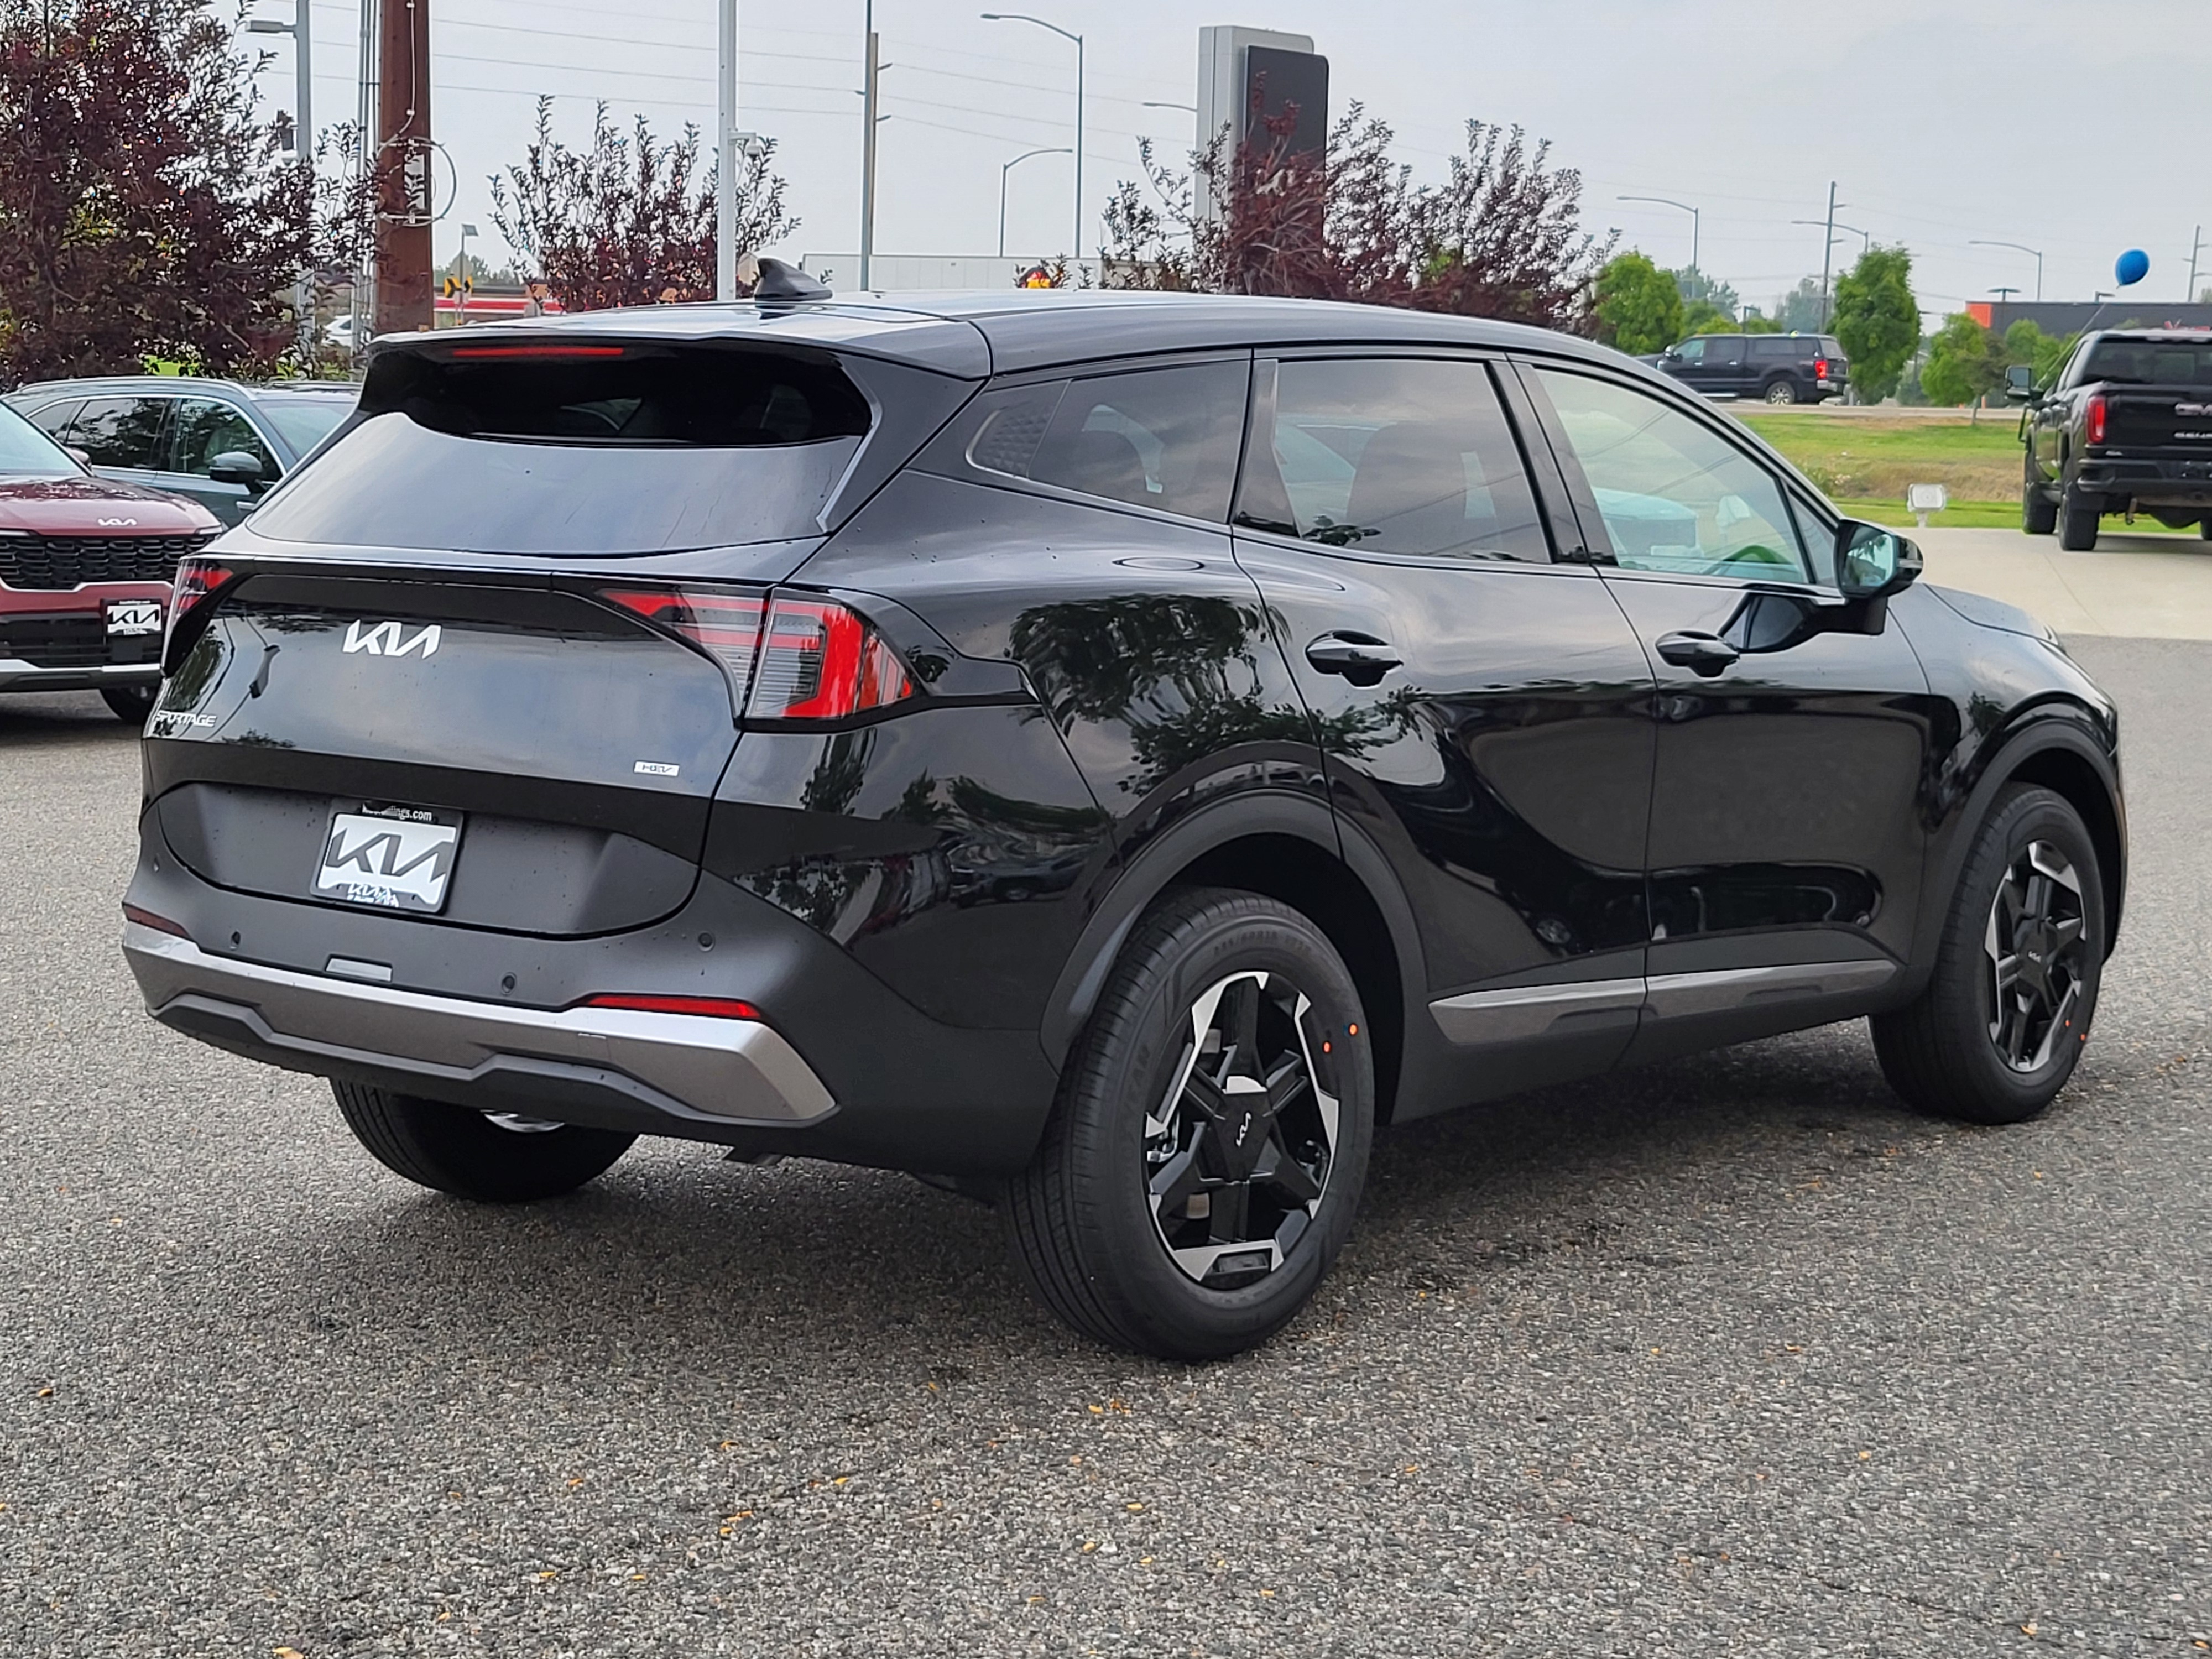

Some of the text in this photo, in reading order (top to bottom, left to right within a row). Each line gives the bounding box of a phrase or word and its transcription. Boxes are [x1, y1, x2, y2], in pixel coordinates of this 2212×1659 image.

[107, 609, 160, 624] KIA
[342, 619, 441, 659] KIA
[155, 710, 217, 728] SPORTAGE
[325, 828, 454, 883] KIA
[1236, 1112, 1251, 1147] KIA
